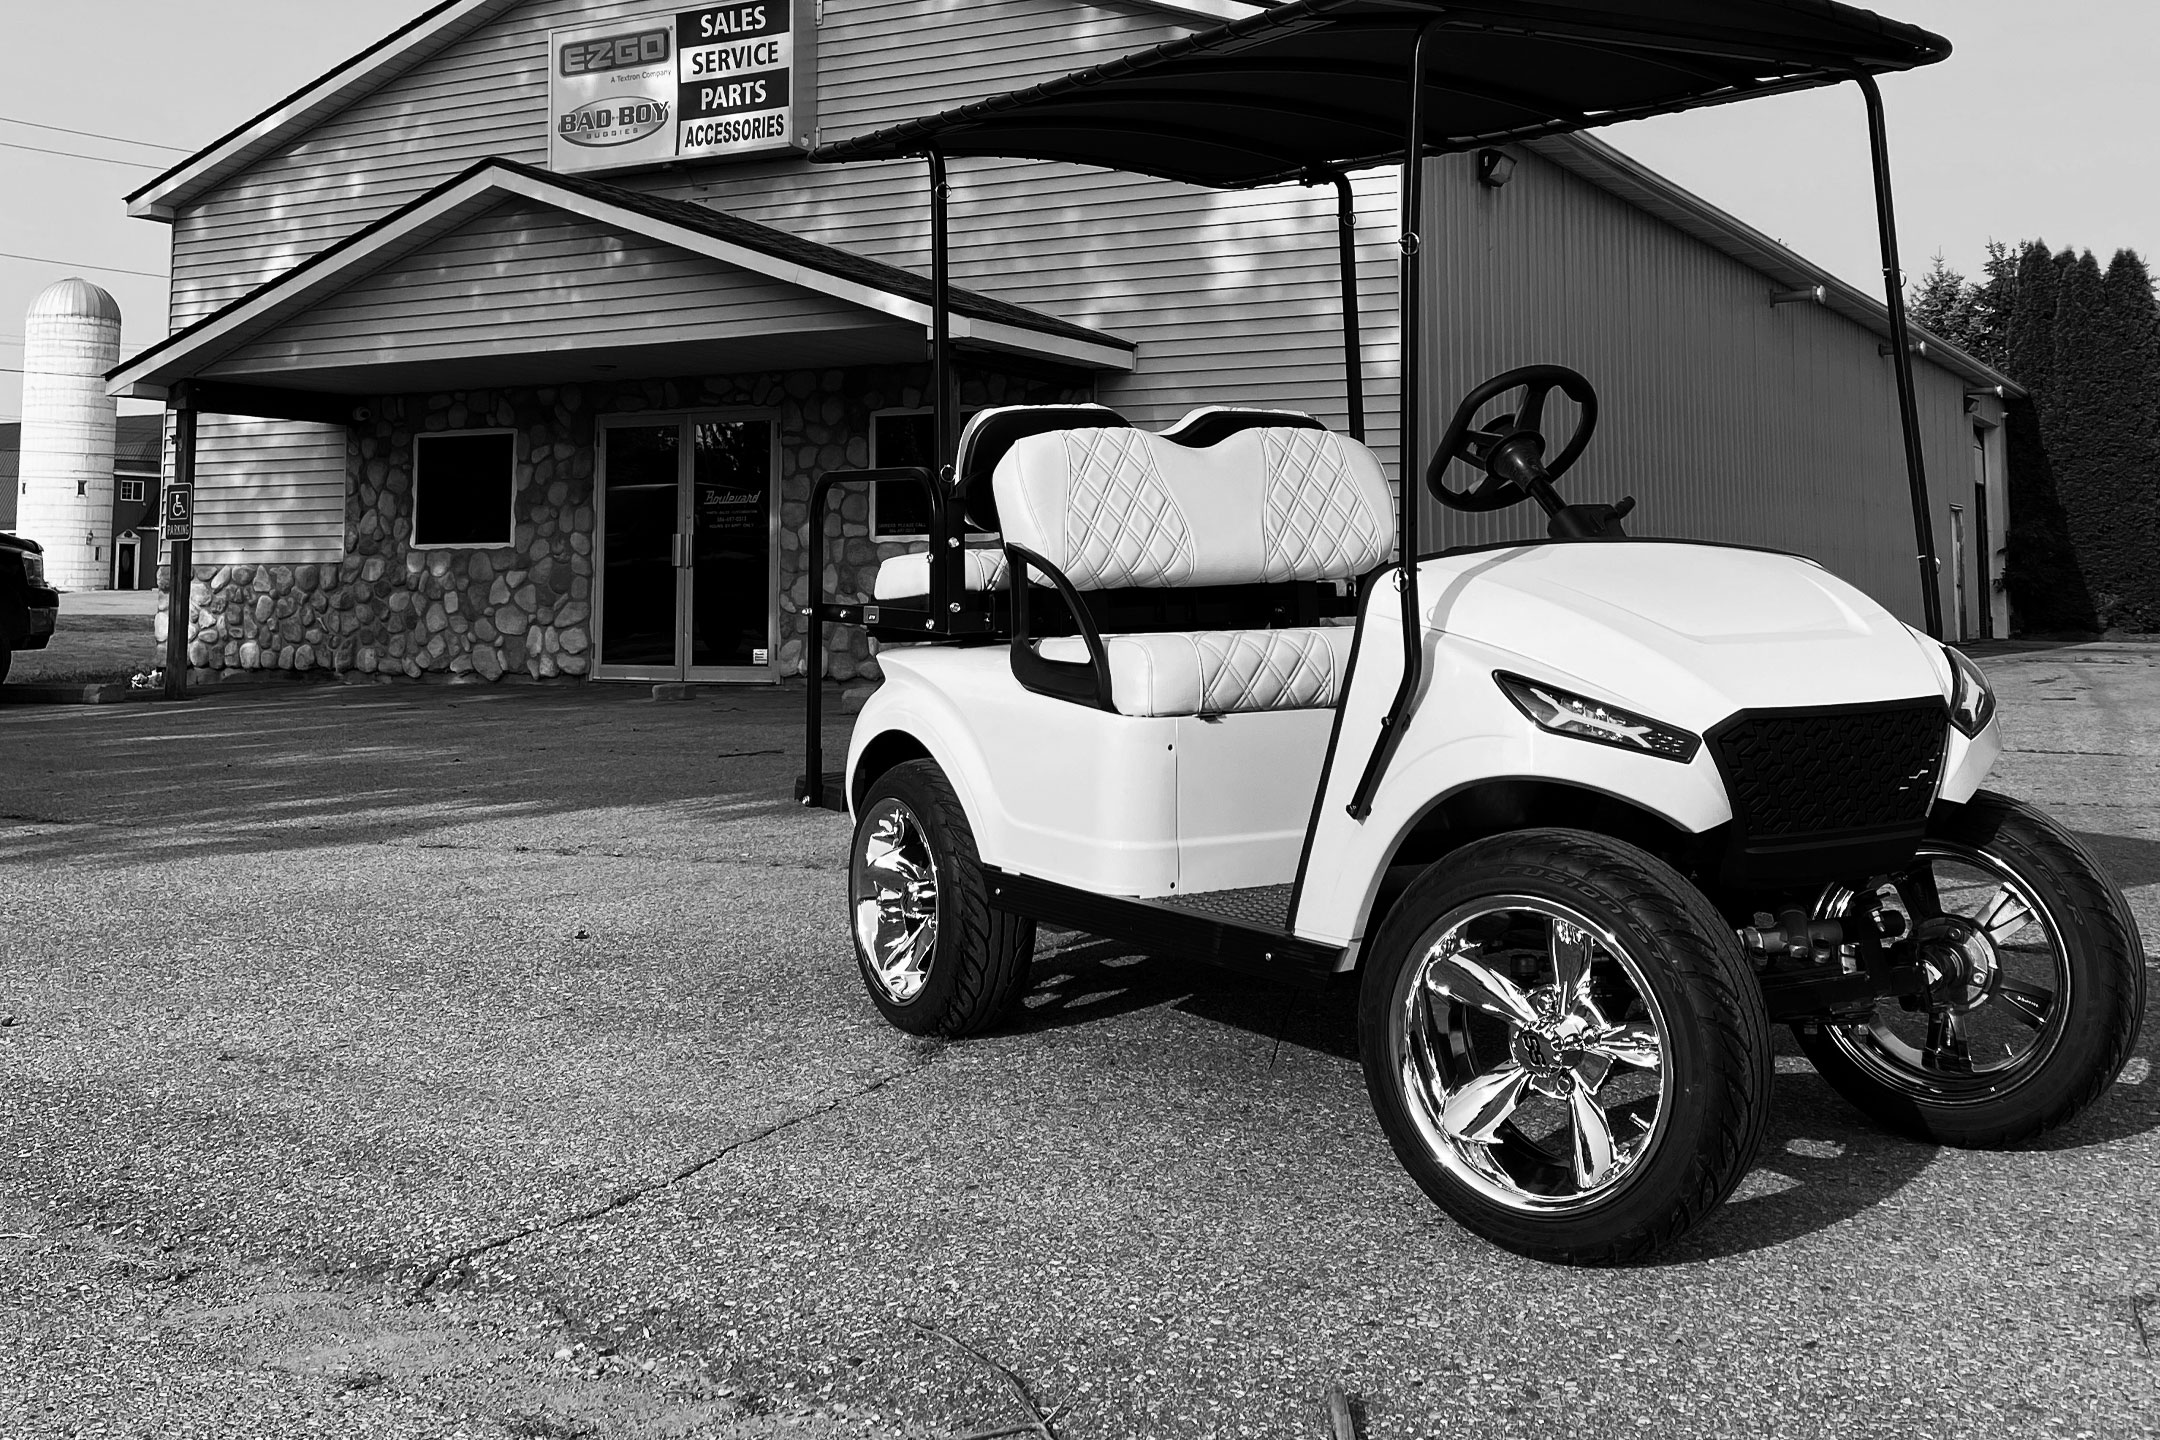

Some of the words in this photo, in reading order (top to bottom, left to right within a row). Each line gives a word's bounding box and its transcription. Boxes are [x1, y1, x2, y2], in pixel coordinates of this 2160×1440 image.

[700, 5, 766, 38] SALES
[564, 32, 666, 73] EZGO
[691, 41, 779, 75] SERVICE
[610, 76, 617, 84] A
[616, 73, 640, 83] Textron
[642, 69, 672, 80] Company
[700, 79, 767, 111] PARTS
[560, 109, 612, 134] BAD
[618, 101, 670, 125] BOY
[586, 127, 639, 140] BUGGIES
[684, 113, 785, 148] ACCESSORIES
[704, 489, 762, 505] Boulevard
[167, 524, 190, 536] PARKING
[1499, 866, 1623, 915] FUSION
